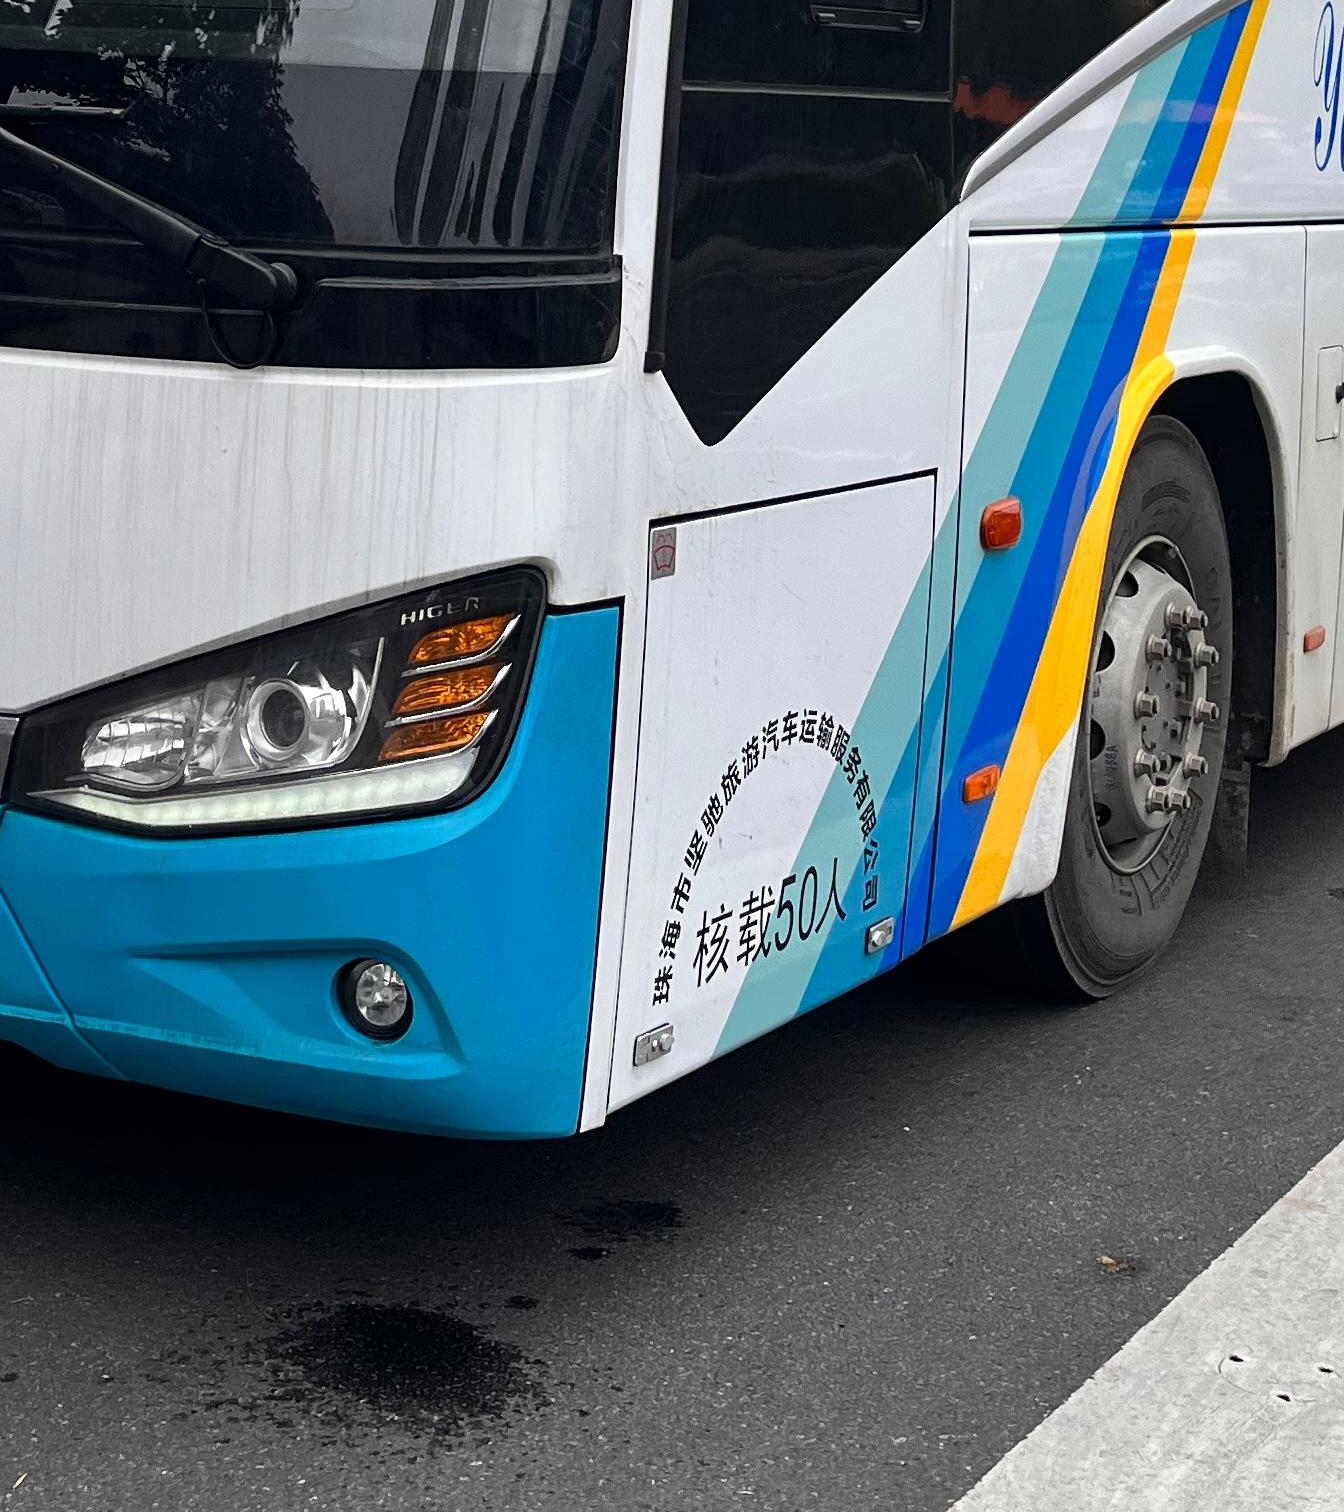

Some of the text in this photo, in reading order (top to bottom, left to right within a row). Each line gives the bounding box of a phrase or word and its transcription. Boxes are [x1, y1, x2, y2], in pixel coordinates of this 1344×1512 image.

[653, 708, 880, 1007] 珠海市坚驰旅游汽车运输服务有限公司
[692, 856, 847, 988] 核载50人
